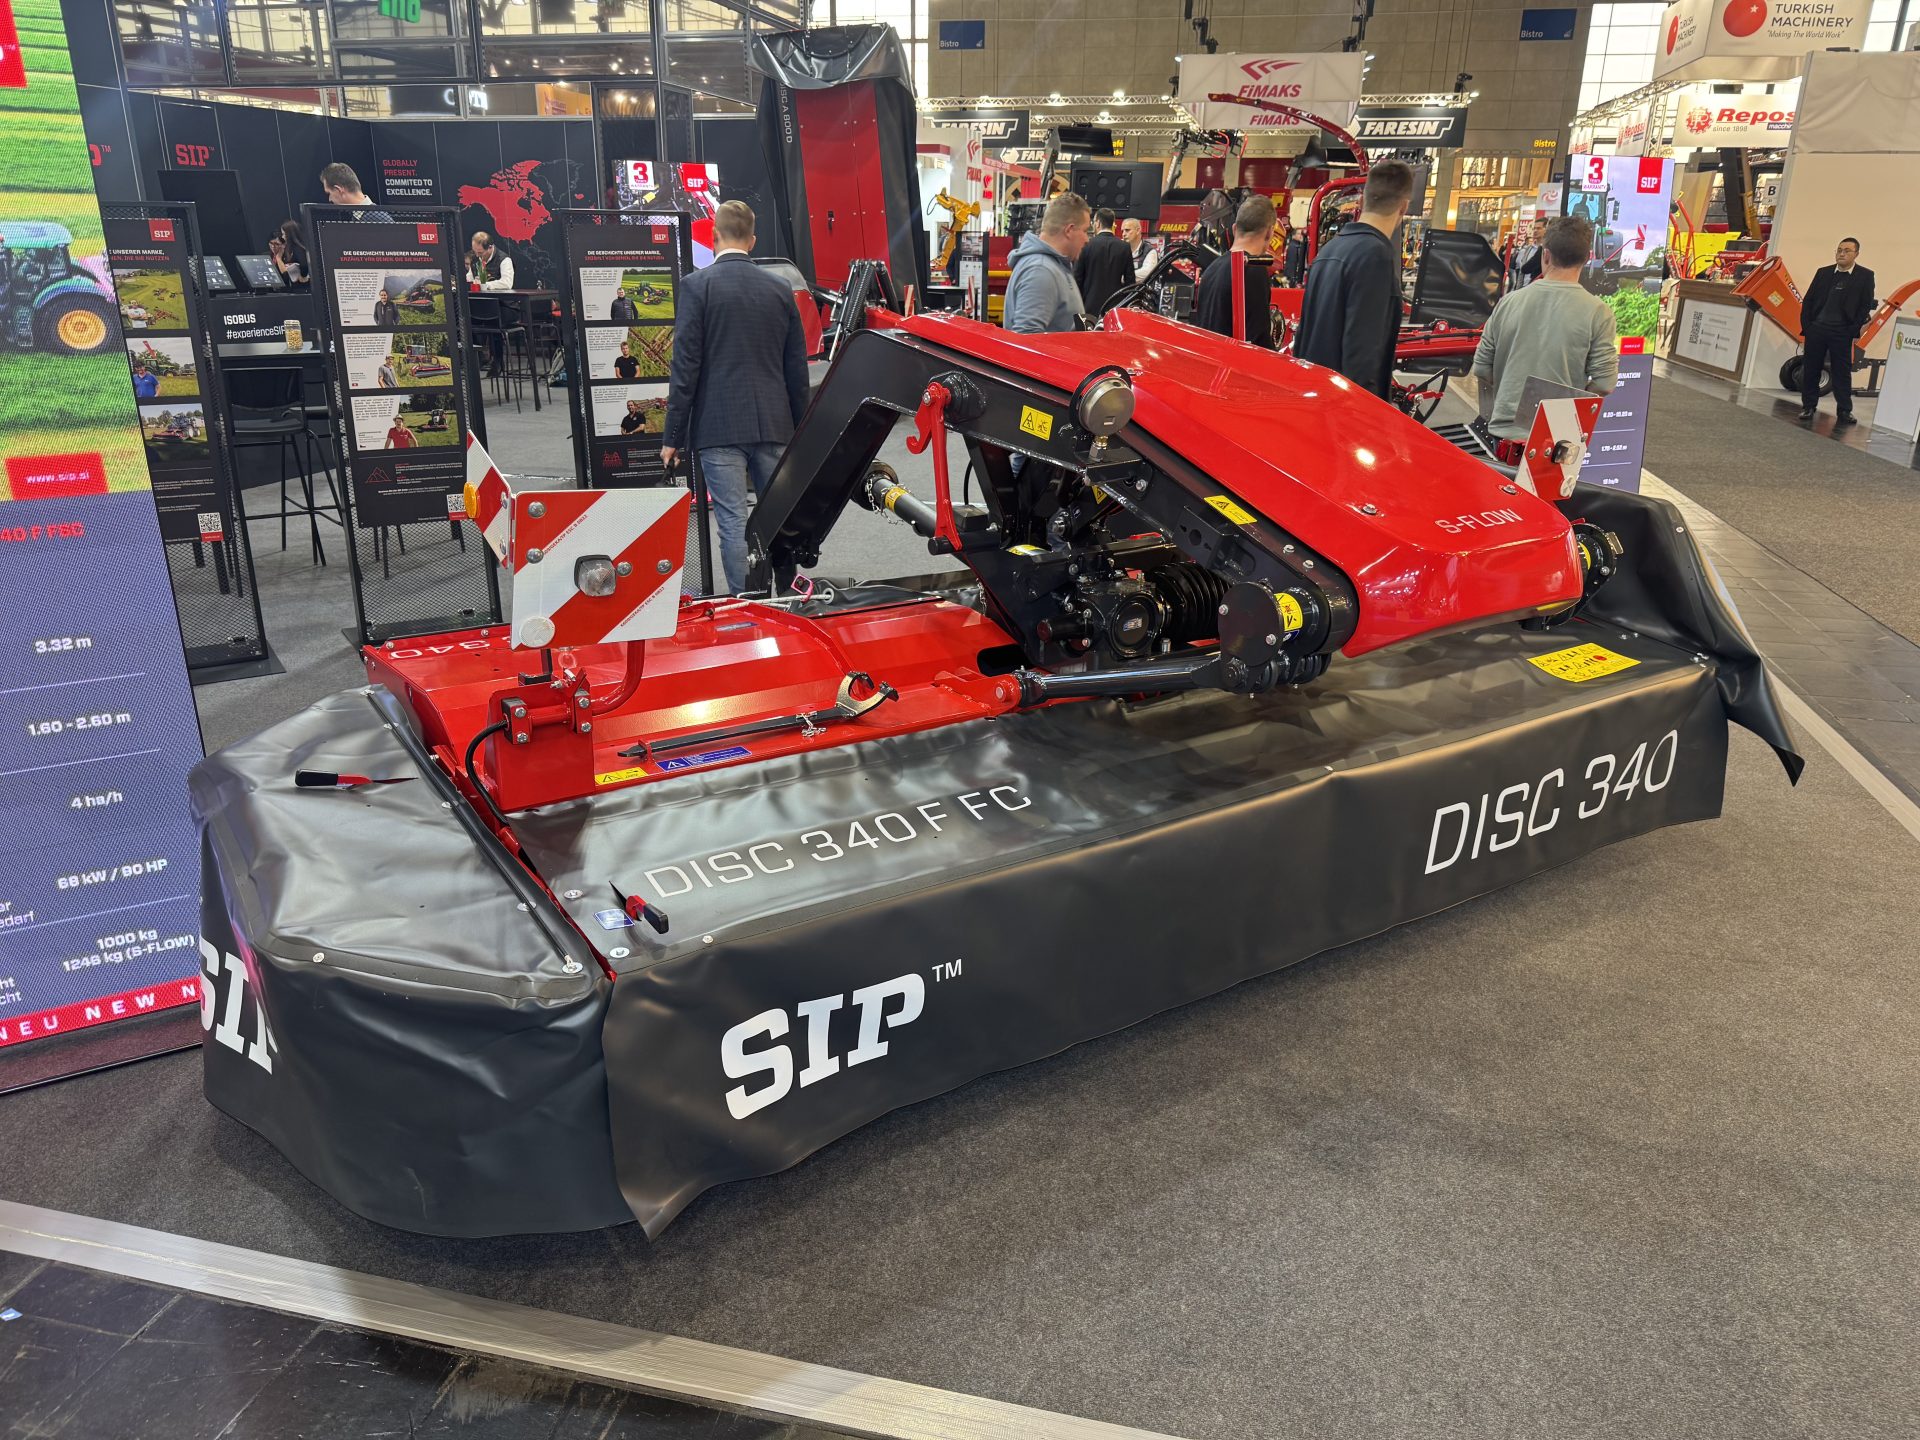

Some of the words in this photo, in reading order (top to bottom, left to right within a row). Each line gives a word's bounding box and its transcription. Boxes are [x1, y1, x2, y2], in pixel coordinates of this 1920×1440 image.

[1776, 4, 1833, 14] TURKISH
[1771, 17, 1853, 27] MACHINERY
[1521, 30, 1543, 38] Bistro
[1363, 121, 1440, 135] FARESIN
[1534, 139, 1556, 147] Bistro
[176, 143, 209, 165] SIP
[1021, 151, 1073, 161] FARIN
[383, 159, 418, 167] GLOBALLY
[1588, 157, 1604, 184] 3
[633, 162, 648, 183] 3
[688, 178, 704, 187] SIP
[1641, 177, 1657, 188] SIP
[386, 188, 433, 196] EXCELLENCE.
[1768, 186, 1776, 196] B
[421, 233, 435, 241] SIP
[654, 233, 667, 241] SIP
[223, 313, 257, 325] ISOBUS
[1435, 508, 1523, 534] S-FLOW
[35, 637, 73, 654] 3.32
[76, 637, 92, 648] m
[28, 719, 63, 736] 1.60
[76, 714, 113, 730] 2.60
[116, 713, 131, 724] m
[71, 797, 82, 809] 4
[85, 791, 123, 807] ha/h
[1424, 768, 1564, 875] DISC
[1578, 729, 1678, 819] 340
[644, 842, 795, 898] DISC
[800, 812, 917, 862] 340
[916, 801, 948, 832] F
[957, 785, 1032, 821] FC
[82, 869, 107, 885] kW
[147, 858, 168, 873] HP
[97, 933, 137, 950] 1000
[138, 929, 158, 945] kg
[103, 951, 123, 968] kg
[125, 935, 196, 962] (S-FLOW)
[85, 993, 155, 1020] NEW
[721, 973, 925, 1120] SIP
